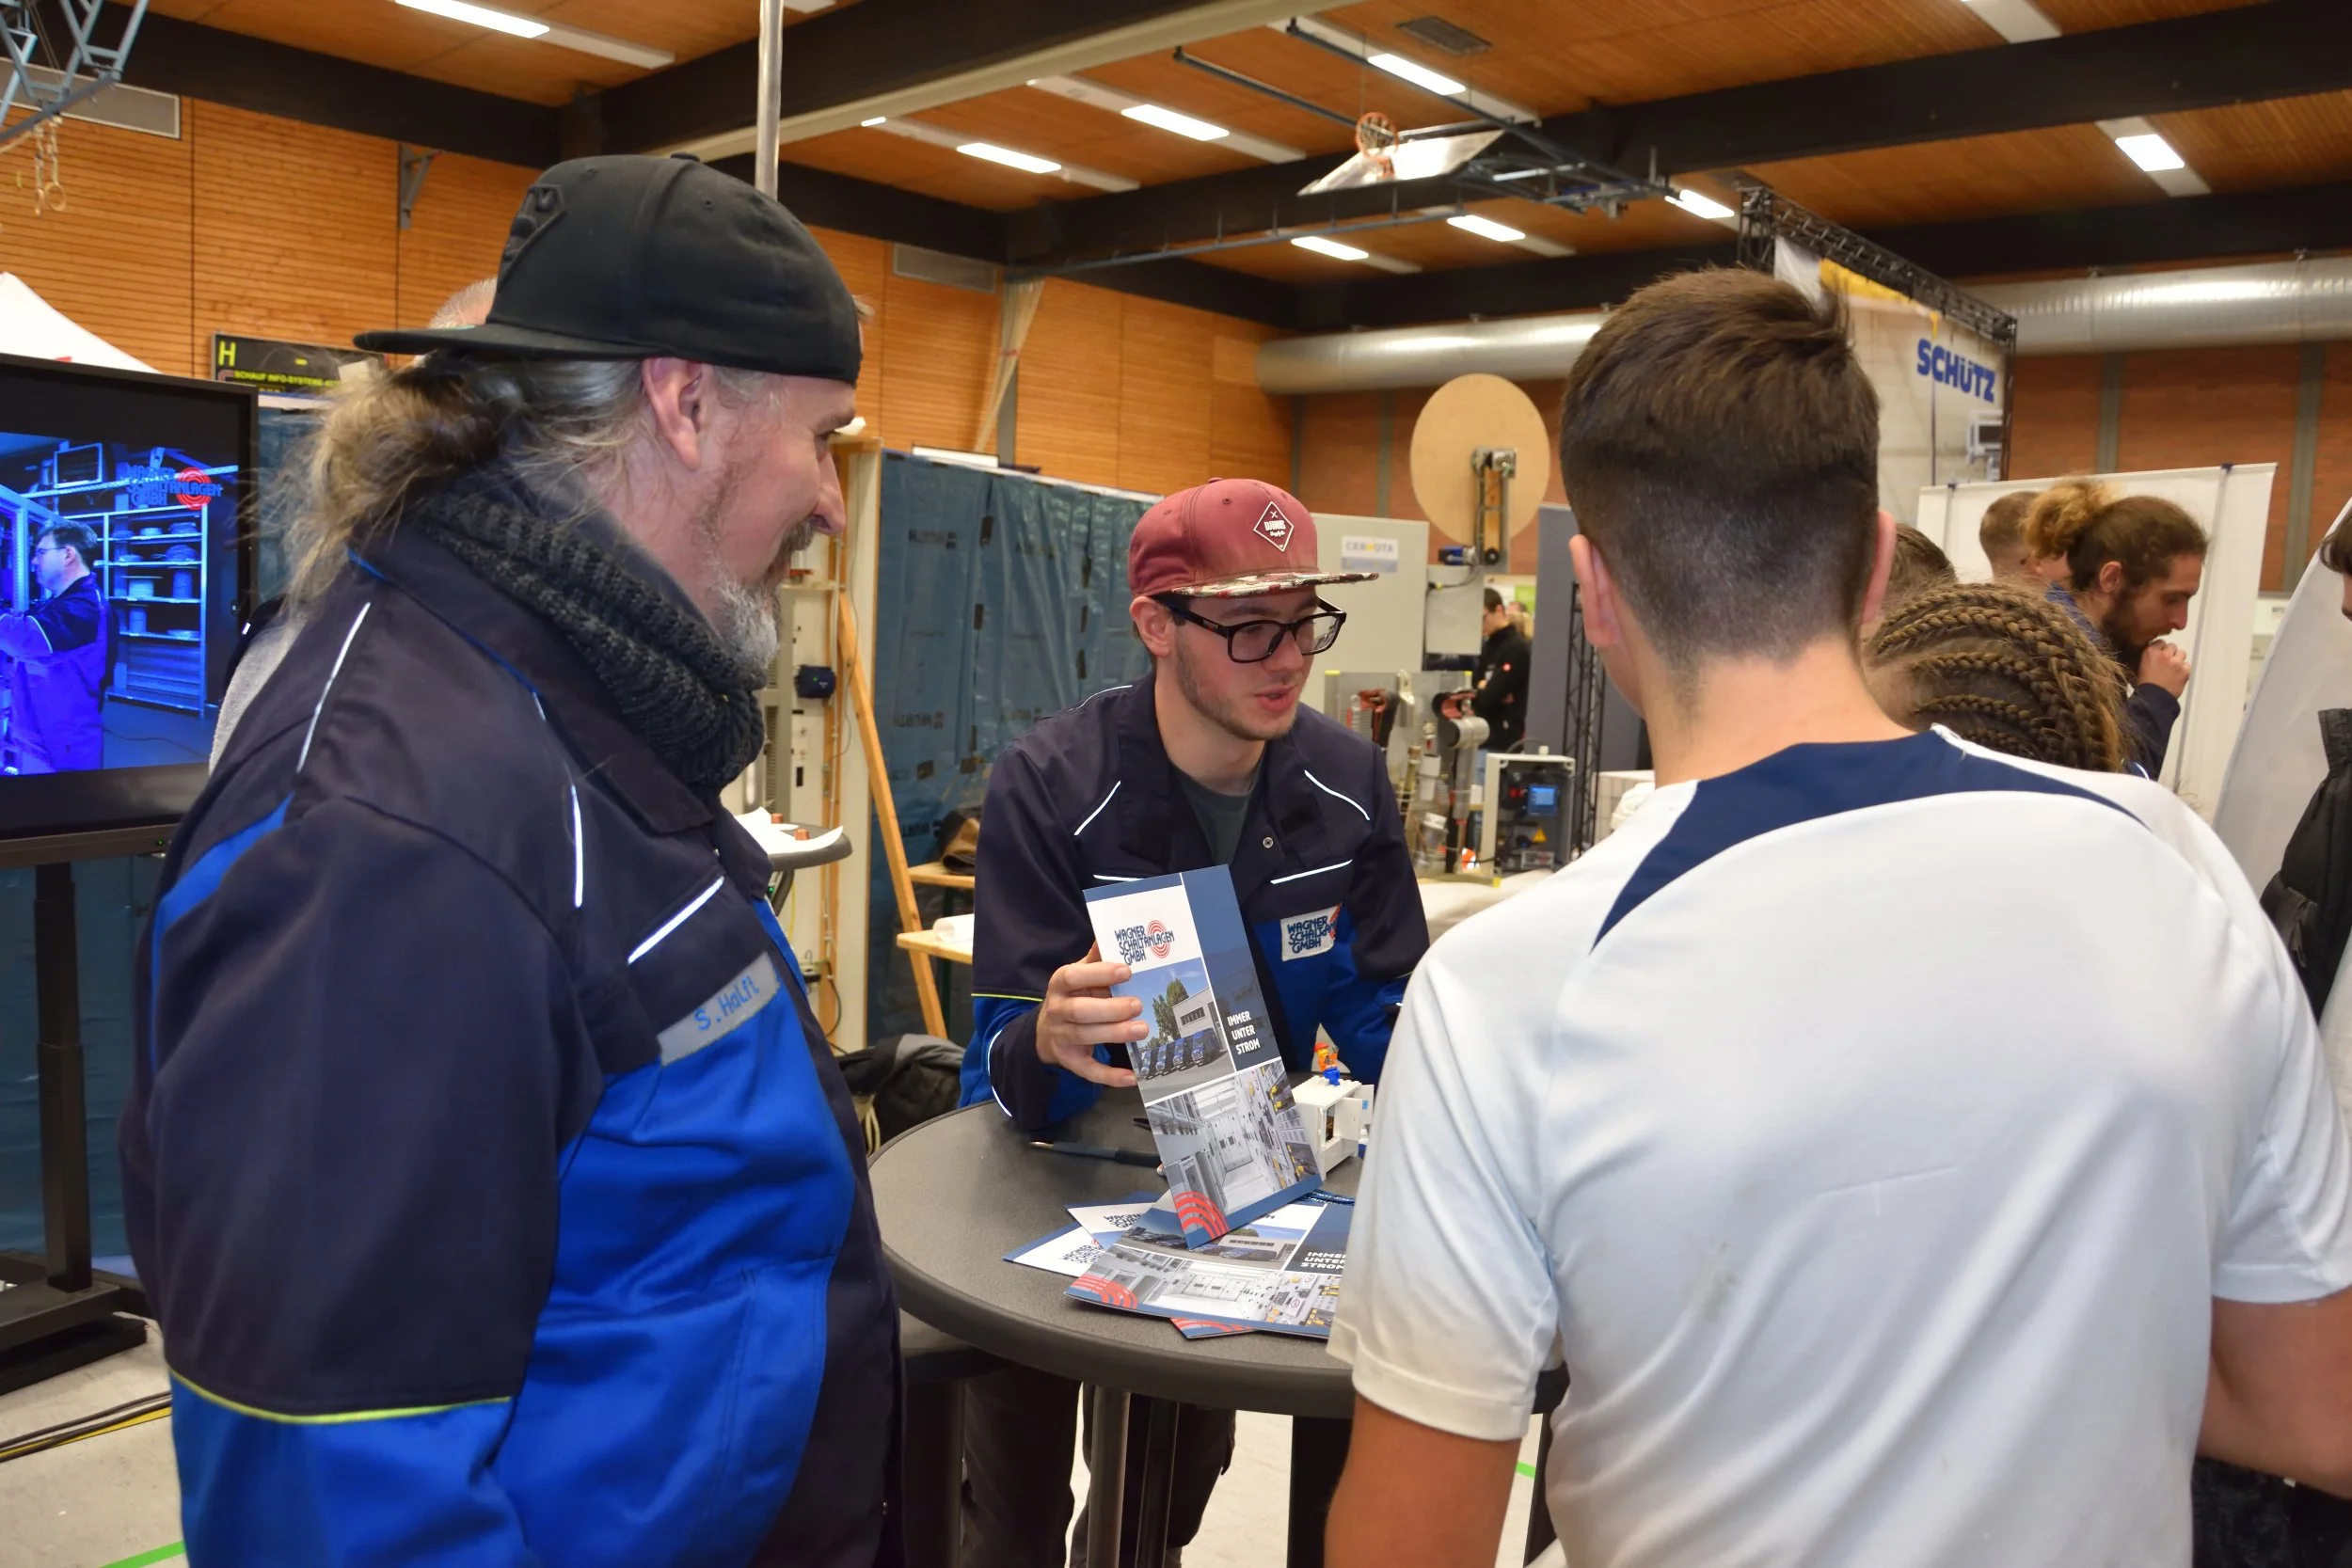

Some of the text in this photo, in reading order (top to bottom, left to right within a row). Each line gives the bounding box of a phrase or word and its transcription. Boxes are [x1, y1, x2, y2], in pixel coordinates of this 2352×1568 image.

[218, 341, 236, 367] H
[1917, 339, 1995, 403] SCHÜTZ
[1287, 915, 1328, 934] WAGNER
[1114, 926, 1147, 942] WAGNER
[1120, 930, 1175, 956] SCHALTANLAGEN
[1292, 937, 1322, 954] GMBH
[1123, 948, 1147, 966] GMBH
[1227, 1010, 1251, 1026] IMMER
[1231, 1024, 1256, 1040] UNTER
[1235, 1037, 1261, 1055] STROM
